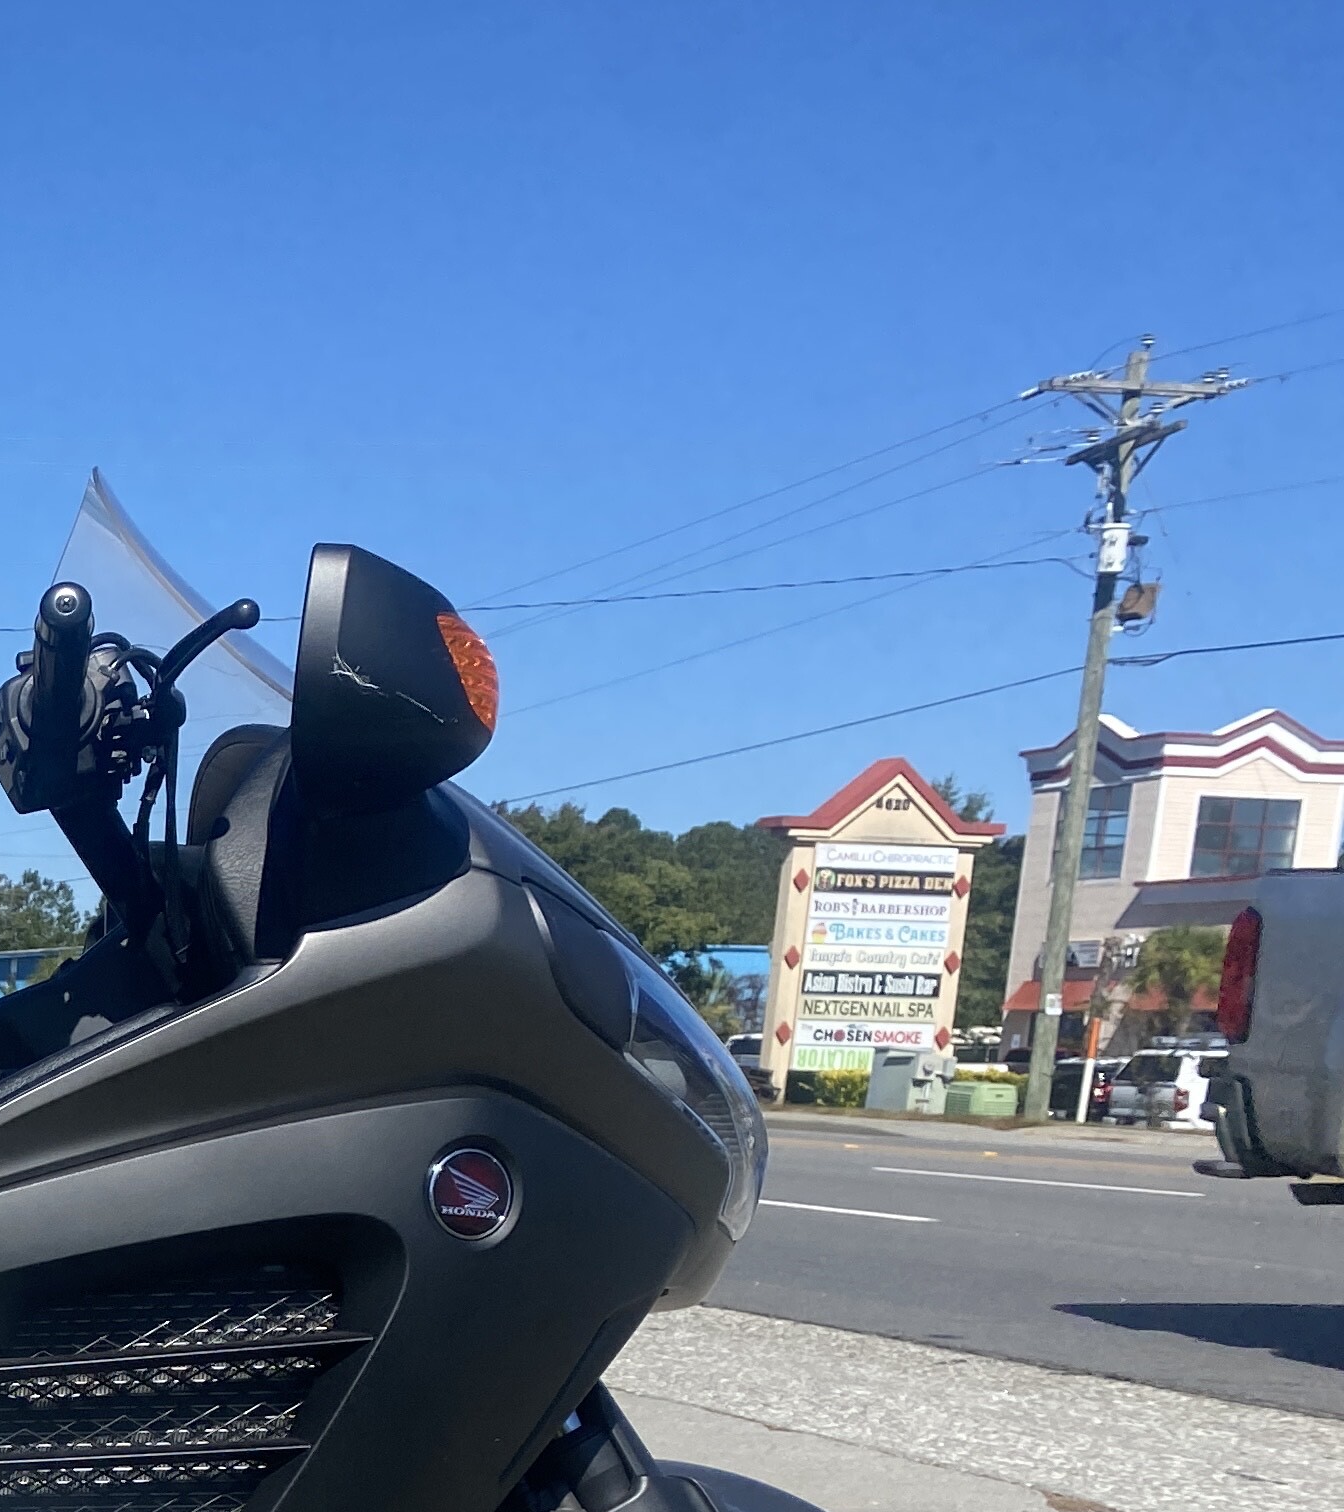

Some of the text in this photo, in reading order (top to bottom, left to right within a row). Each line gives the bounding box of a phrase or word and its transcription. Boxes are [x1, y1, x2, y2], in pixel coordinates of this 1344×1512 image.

[836, 873, 876, 888] FOX'S
[879, 875, 920, 890] PIZZA
[814, 900, 947, 916] ROB'S BARBERSHOP
[829, 923, 946, 943] BAKES & CAKES
[856, 950, 907, 969] Country
[803, 972, 836, 992] Asian
[837, 973, 873, 993] Bistro
[884, 974, 915, 995] Sushi
[916, 975, 938, 995] Bar
[802, 999, 934, 1018] NEXTGEN NAIL SPA
[873, 1030, 923, 1044] SMOKE
[440, 1205, 498, 1219] HONDA
